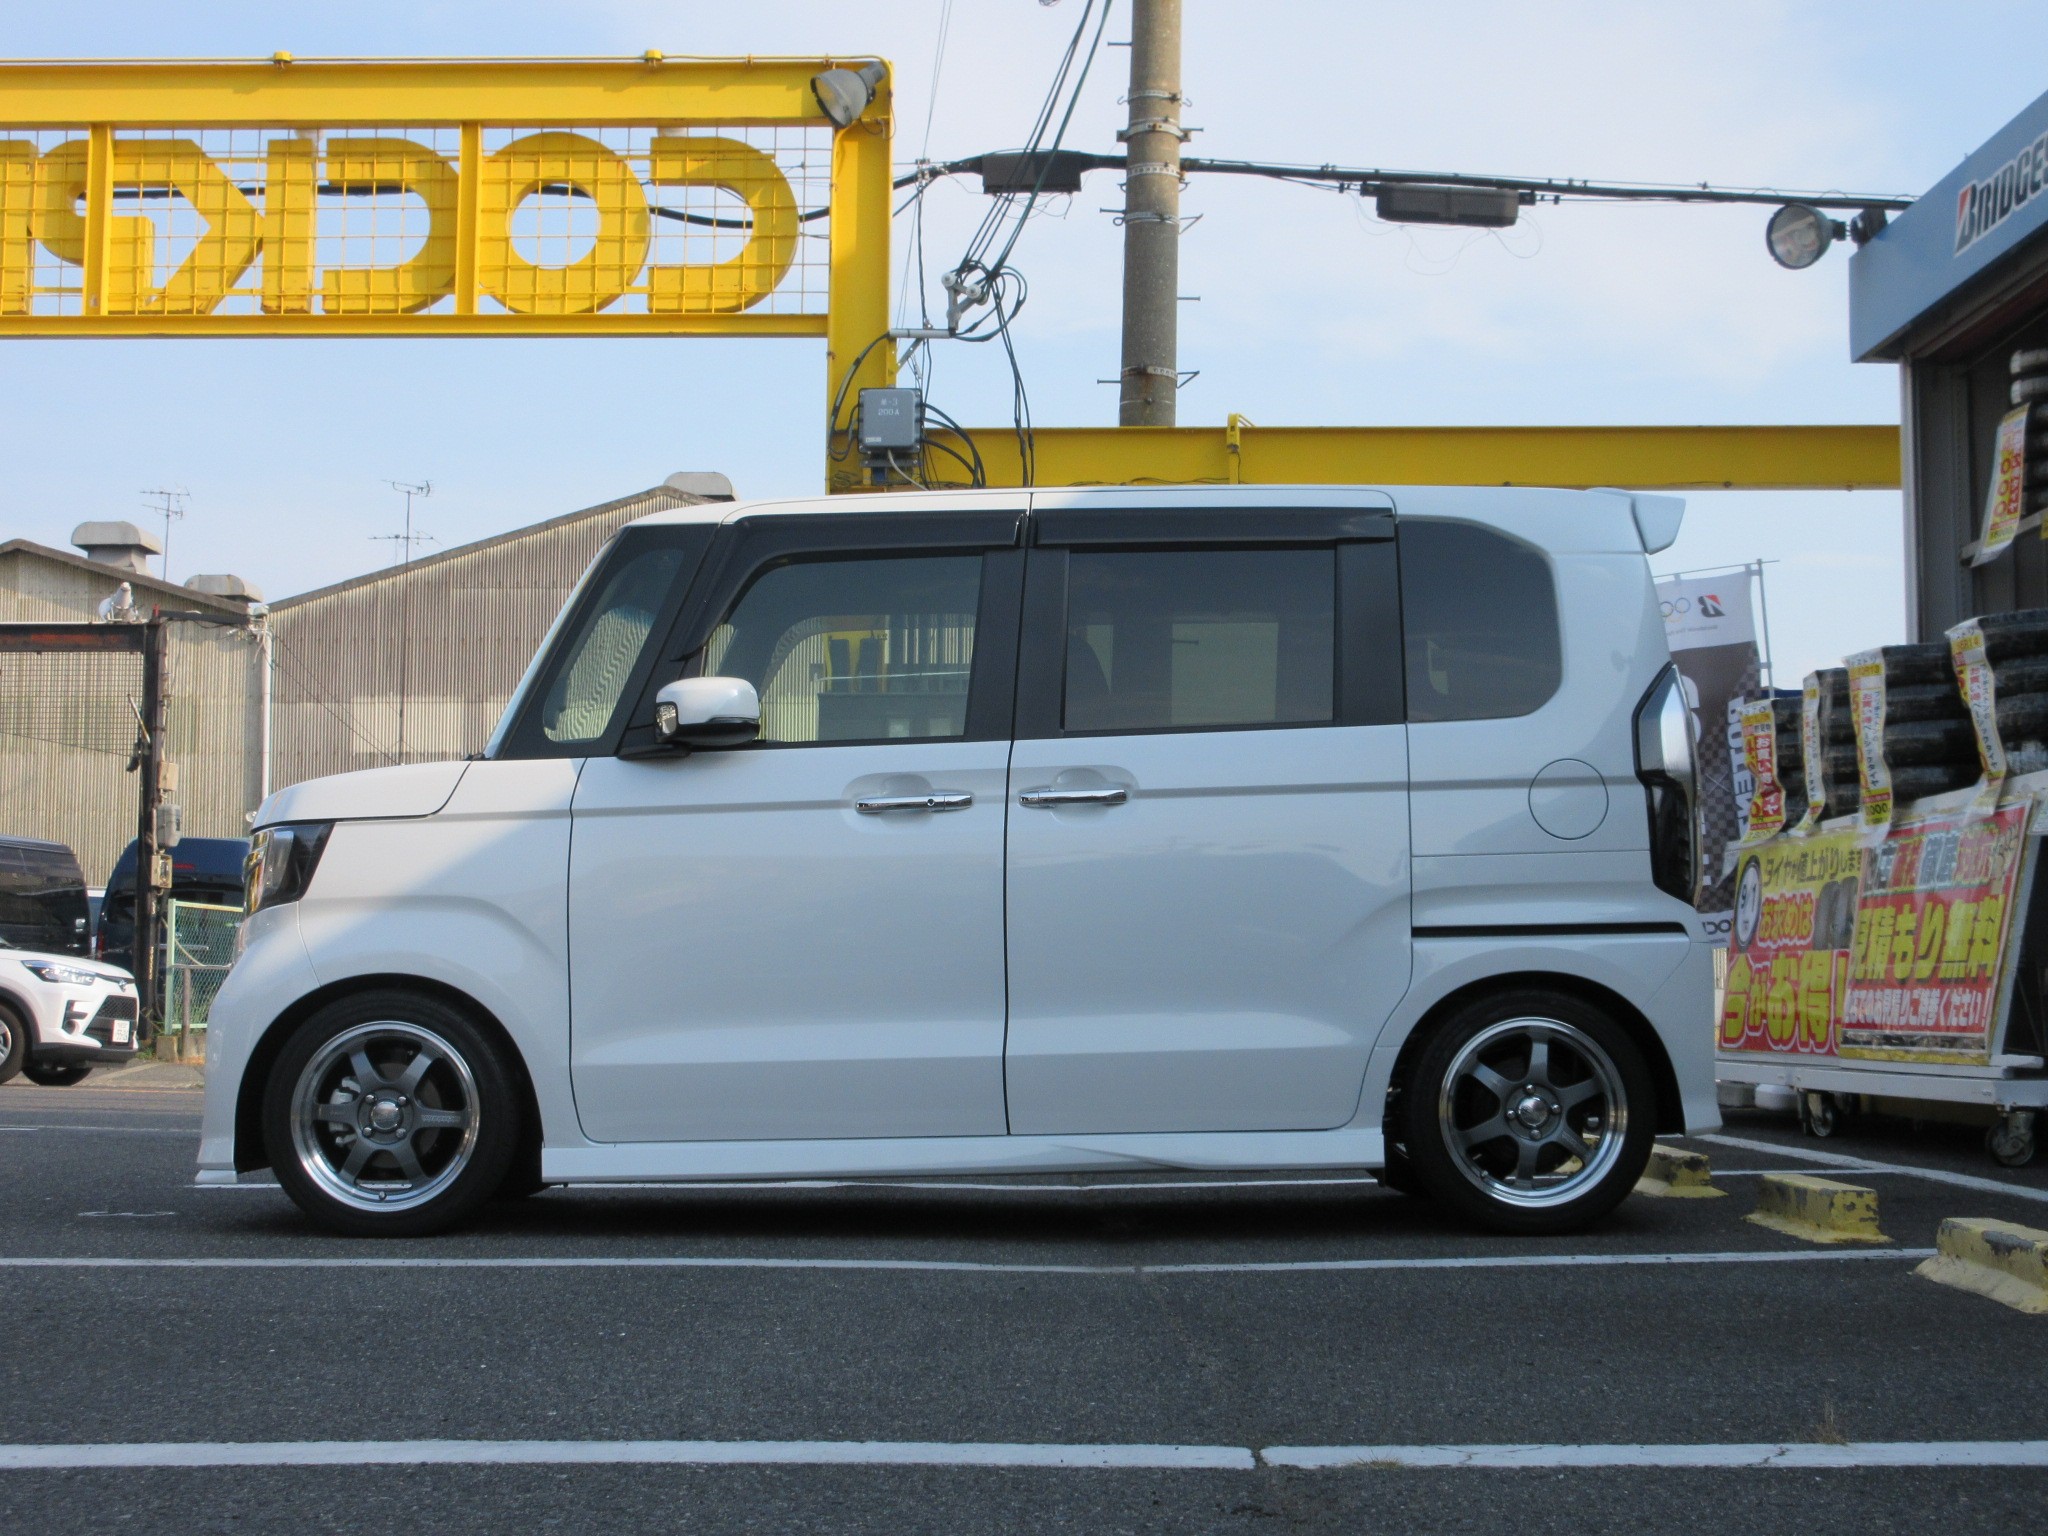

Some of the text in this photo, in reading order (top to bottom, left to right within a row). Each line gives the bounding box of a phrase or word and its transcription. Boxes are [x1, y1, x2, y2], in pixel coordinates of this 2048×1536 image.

[1957, 132, 2048, 251] BRIDGE
[1758, 894, 1814, 941] お求めは
[1851, 892, 2006, 982] 見積もり無料
